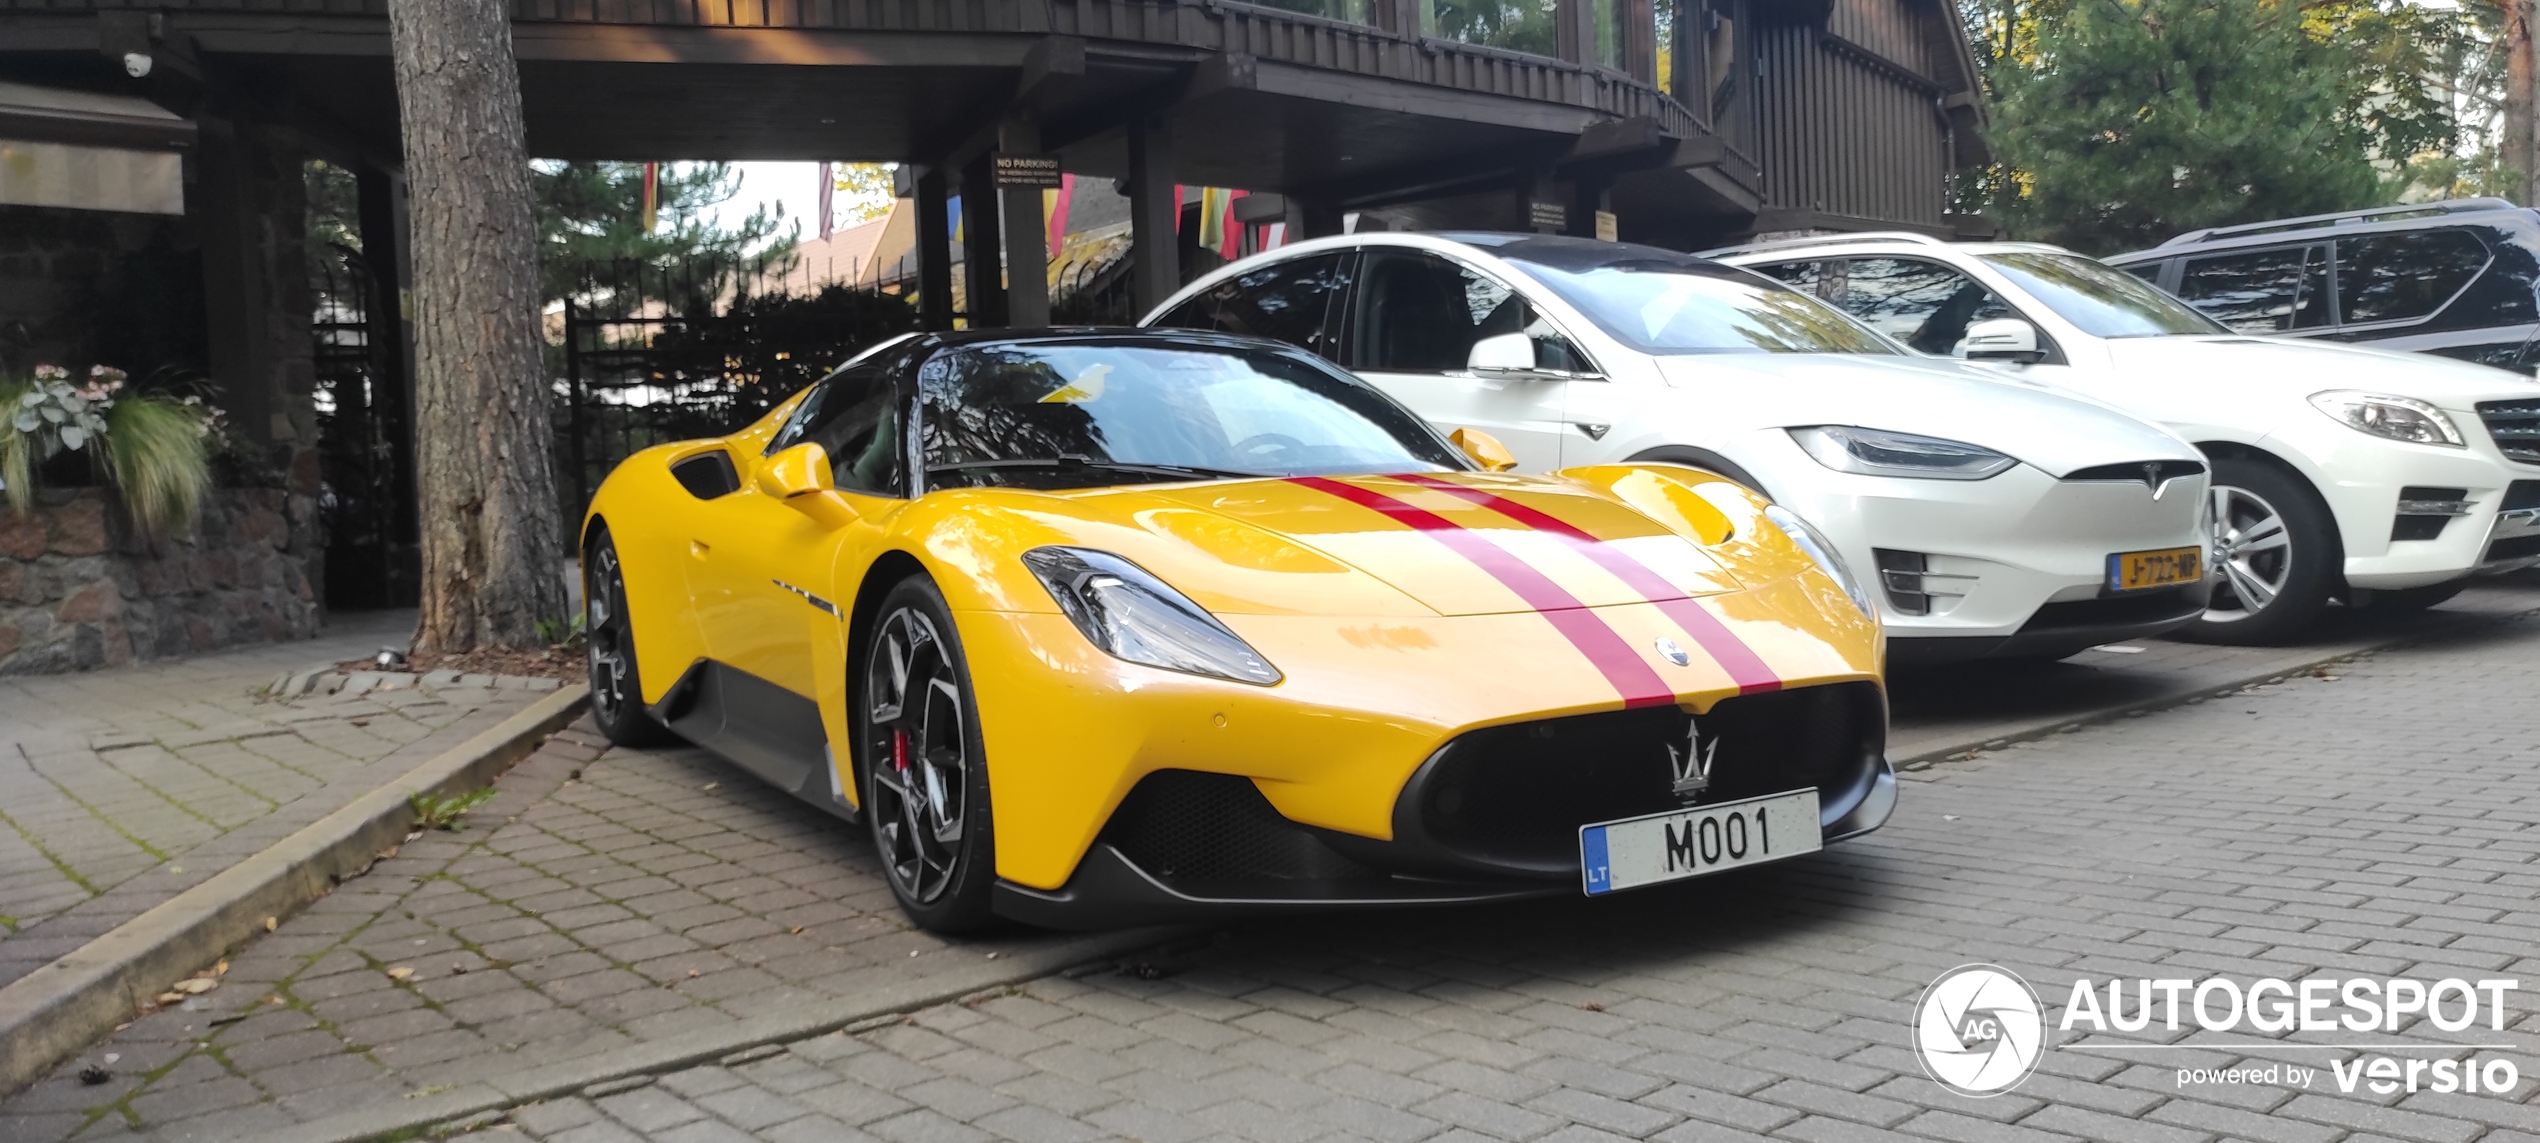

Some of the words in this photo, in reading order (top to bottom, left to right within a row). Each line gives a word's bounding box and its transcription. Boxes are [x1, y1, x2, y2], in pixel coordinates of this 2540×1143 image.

[997, 158, 1012, 168] NO
[1013, 159, 1059, 169] PARKING!
[1665, 806, 1769, 872] M001
[1588, 866, 1608, 883] LT
